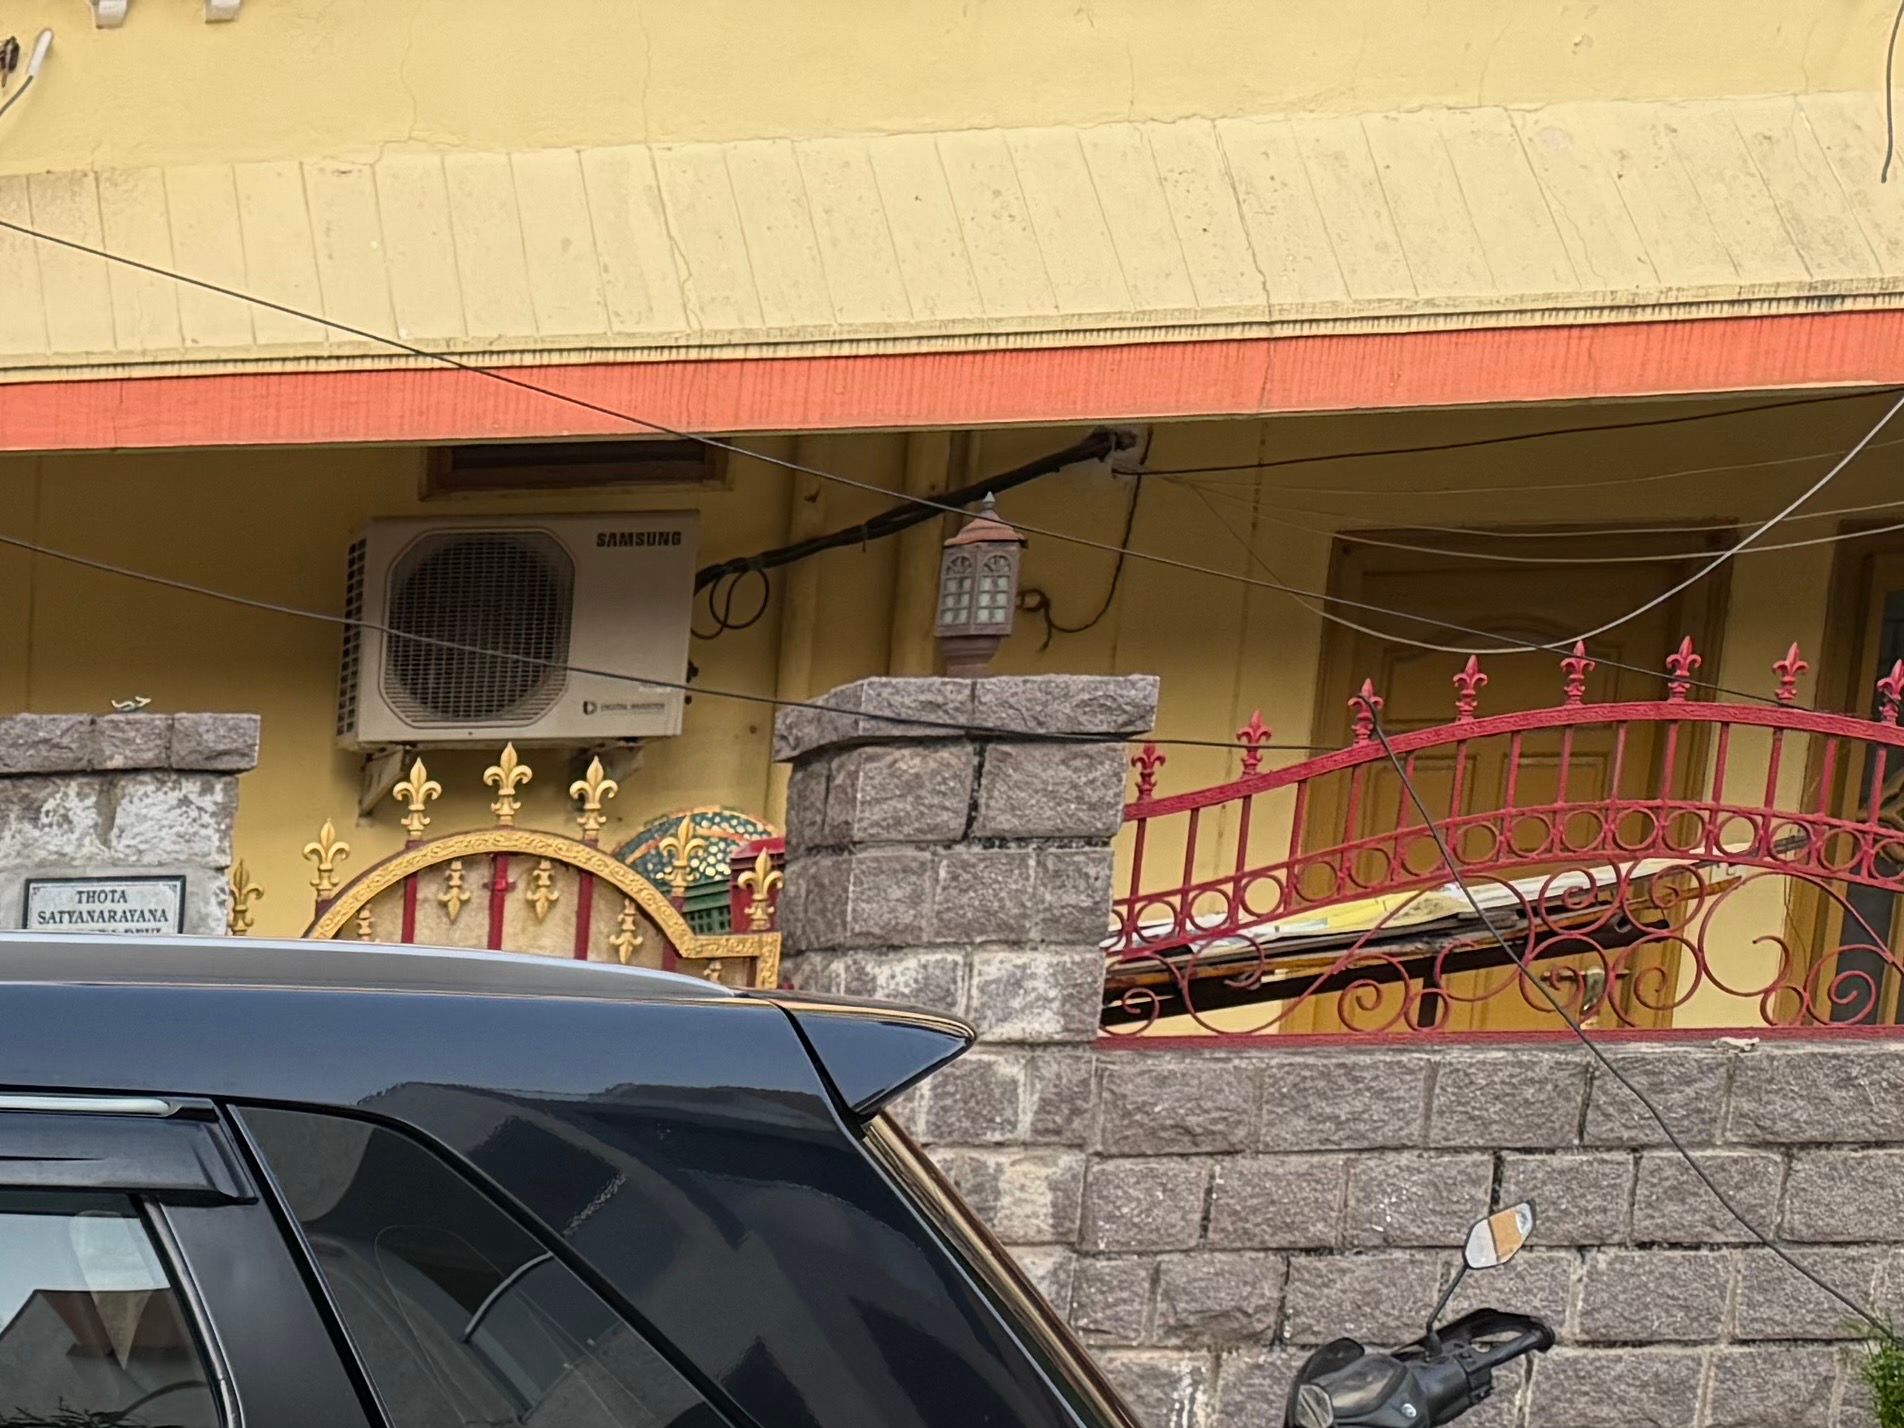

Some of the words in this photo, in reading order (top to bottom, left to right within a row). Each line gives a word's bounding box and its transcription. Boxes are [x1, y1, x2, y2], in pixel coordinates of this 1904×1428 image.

[596, 531, 682, 547] SAMSUNG
[76, 889, 128, 905] THOTA
[37, 907, 169, 926] SATYANARAYANA
